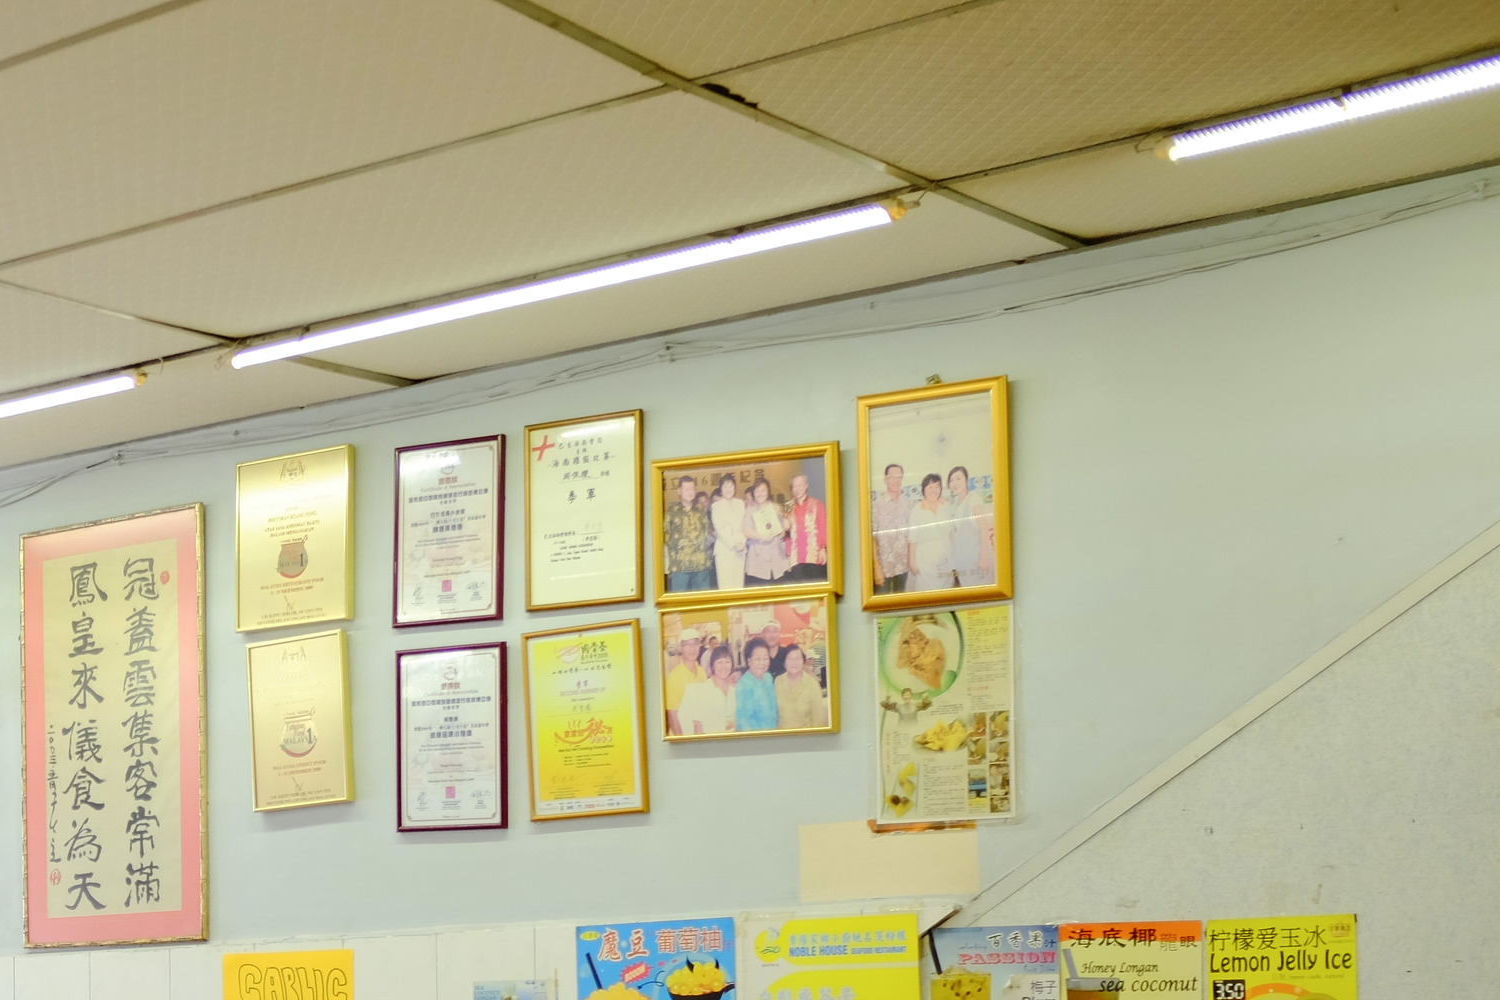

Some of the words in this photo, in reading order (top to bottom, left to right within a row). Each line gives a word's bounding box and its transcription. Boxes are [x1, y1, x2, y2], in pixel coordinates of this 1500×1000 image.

[598, 927, 649, 962] 魔豆
[1068, 928, 1157, 948] 海底椰
[1208, 925, 1327, 952] 柠檬爱玉冰
[789, 946, 817, 957] NOBLE
[819, 945, 848, 956] HOUSE
[958, 951, 1057, 965] PASSION
[1081, 961, 1116, 977] Honey
[1119, 962, 1159, 977] Longan
[1210, 953, 1270, 973] Lemon
[1277, 950, 1318, 972] Jelly
[1325, 949, 1352, 969] Ice
[1030, 980, 1057, 995] 梅子
[1098, 979, 1125, 992] sea
[1131, 976, 1199, 992] coconut
[1215, 981, 1245, 1000] 3.50
